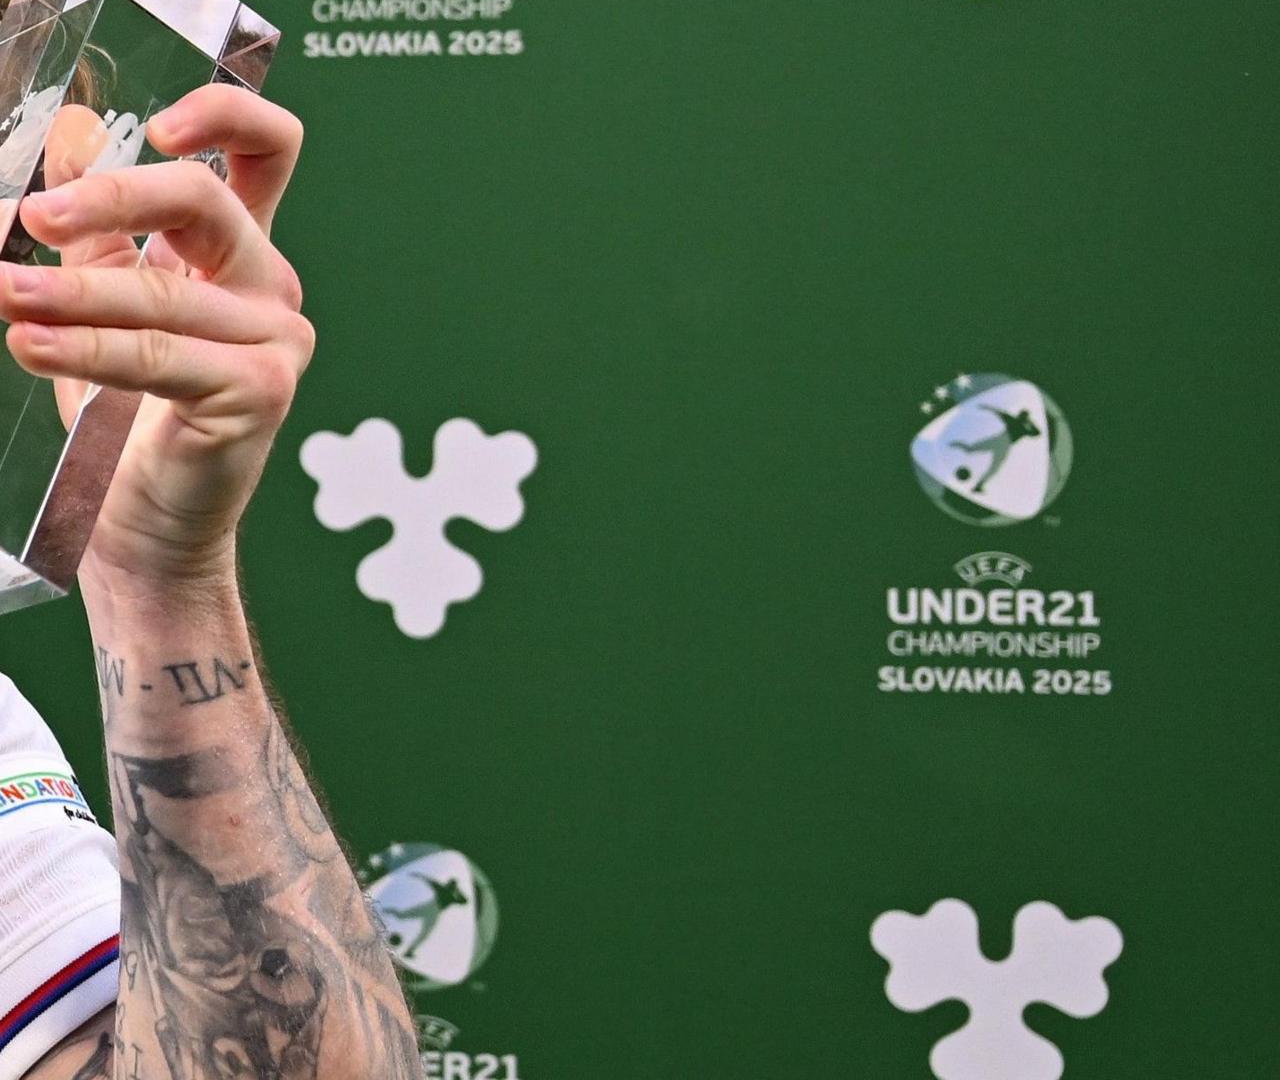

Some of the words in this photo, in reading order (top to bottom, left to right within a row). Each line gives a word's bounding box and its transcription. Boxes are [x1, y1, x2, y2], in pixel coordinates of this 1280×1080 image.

[304, 31, 441, 58] SLOVAKIA
[448, 30, 523, 55] 2025
[887, 587, 1101, 626] UNDER21
[887, 630, 1101, 658] CHAMPIONSHIP
[878, 666, 1024, 693] SLOVAKIA
[1032, 669, 1112, 695] 2025
